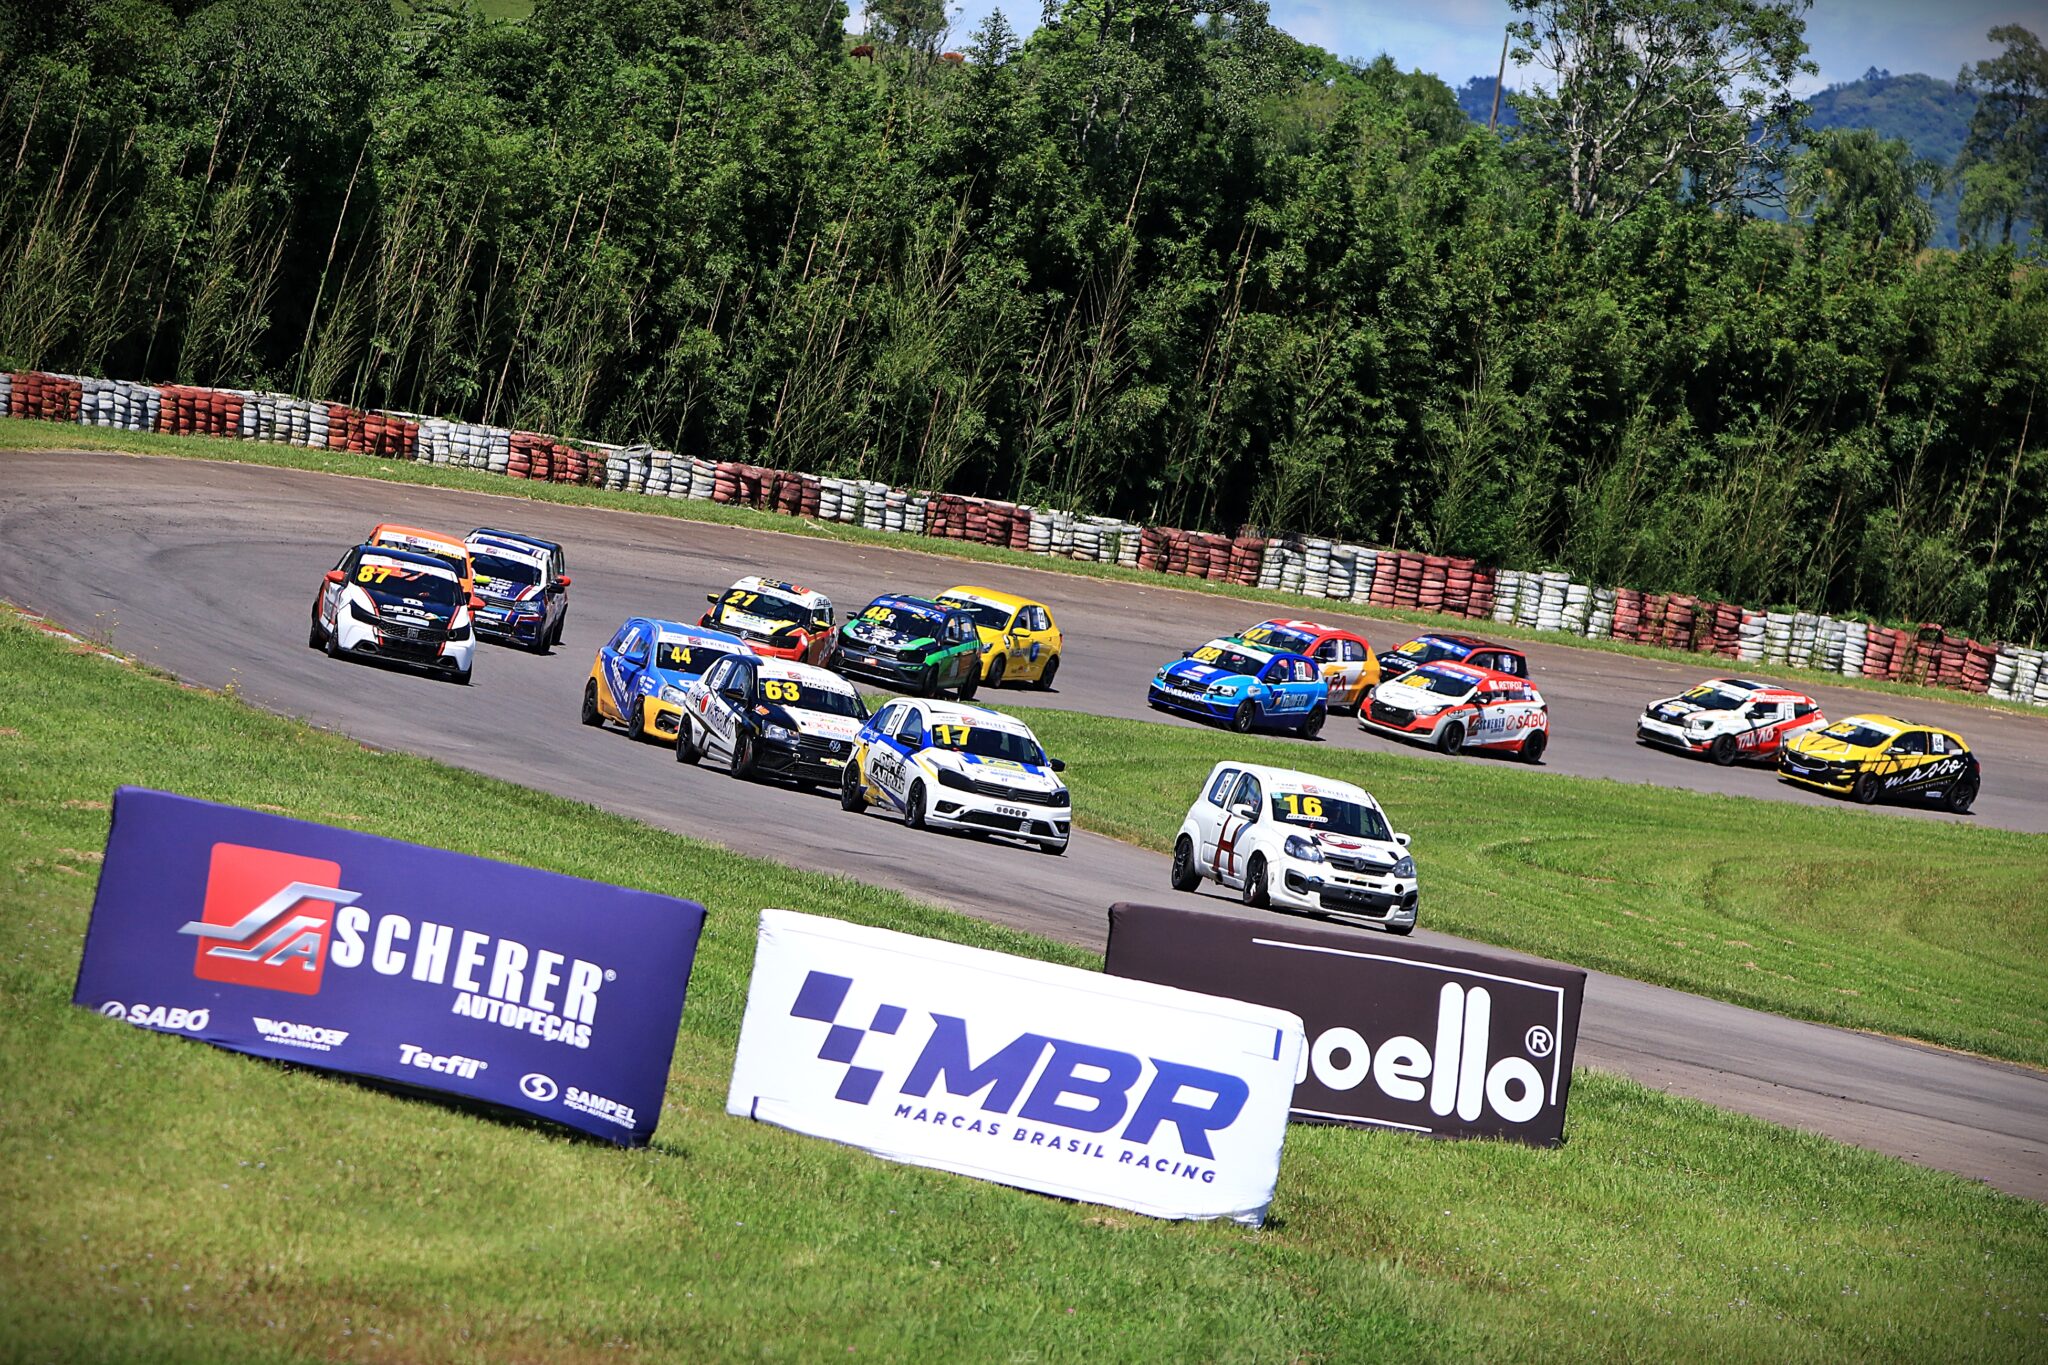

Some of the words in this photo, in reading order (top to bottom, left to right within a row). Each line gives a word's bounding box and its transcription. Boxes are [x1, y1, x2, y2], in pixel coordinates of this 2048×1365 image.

[357, 565, 392, 584] 87
[725, 590, 759, 607] 21
[863, 606, 892, 621] 48
[670, 646, 692, 664] 44
[1192, 646, 1223, 661] 09
[765, 680, 800, 702] 63
[1164, 685, 1202, 701] BARRANCO
[935, 724, 971, 746] 17
[1283, 794, 1323, 817] 16
[330, 905, 603, 1025] SCHERER
[452, 991, 592, 1049] AUTOPEÇAS
[257, 1018, 345, 1046] MONROE
[399, 1043, 480, 1079] Tecfil
[1295, 981, 1545, 1123] oello
[899, 1011, 1250, 1161] MBR
[565, 1086, 637, 1124] SAMPEL
[894, 1103, 1001, 1136] MARCAS
[1012, 1127, 1105, 1159] BRASIL
[1118, 1150, 1218, 1184] RACING
